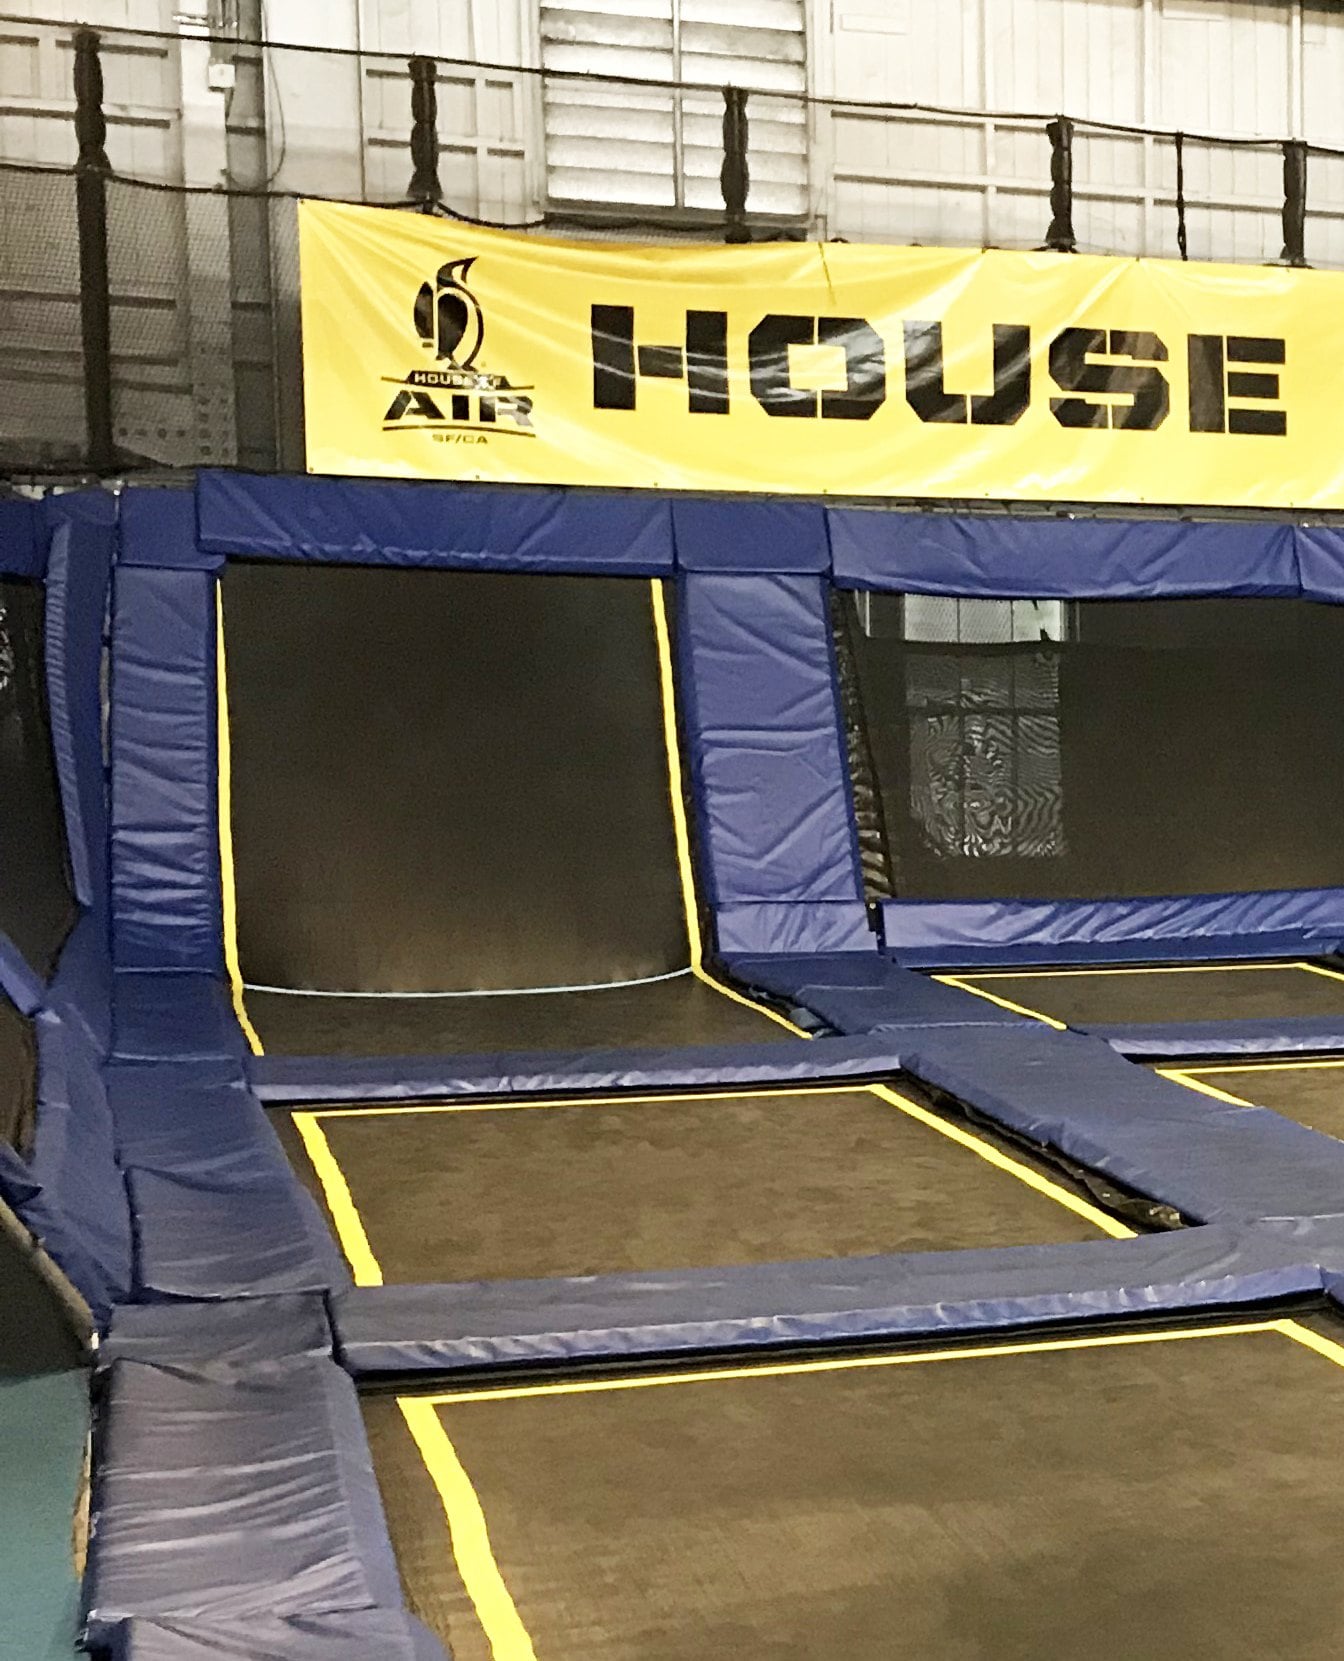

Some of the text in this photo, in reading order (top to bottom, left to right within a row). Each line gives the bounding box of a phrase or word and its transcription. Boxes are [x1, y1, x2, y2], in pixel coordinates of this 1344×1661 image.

[592, 304, 1287, 435] HOUSE
[384, 390, 533, 427] AIR
[432, 434, 488, 444] SF/CA
